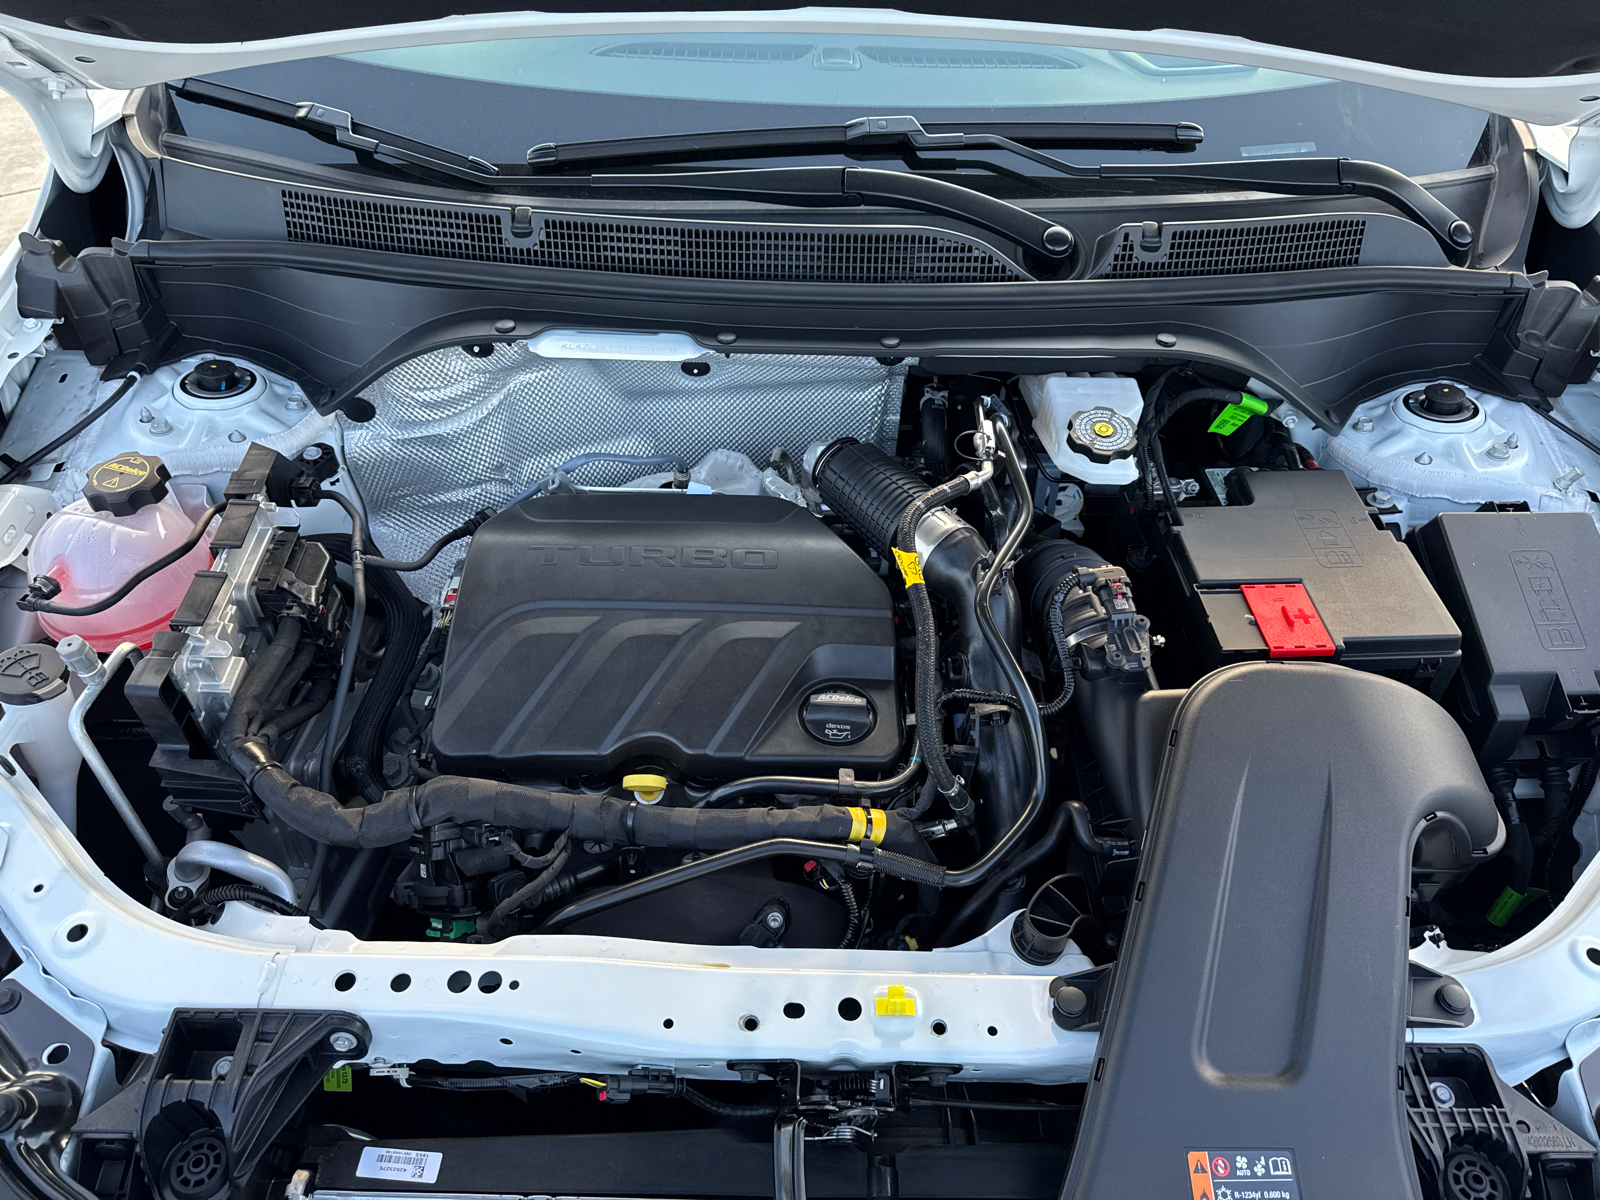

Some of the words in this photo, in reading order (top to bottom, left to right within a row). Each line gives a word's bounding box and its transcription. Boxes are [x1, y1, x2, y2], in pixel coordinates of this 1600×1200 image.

[106, 462, 148, 476] ACDelco
[528, 545, 779, 569] TURBO
[816, 694, 862, 703] ACDelco
[826, 722, 851, 730] dexos
[1234, 1191, 1262, 1200] R-1234yf
[1264, 1191, 1281, 1199] 0.600
[1282, 1191, 1290, 1200] kg
